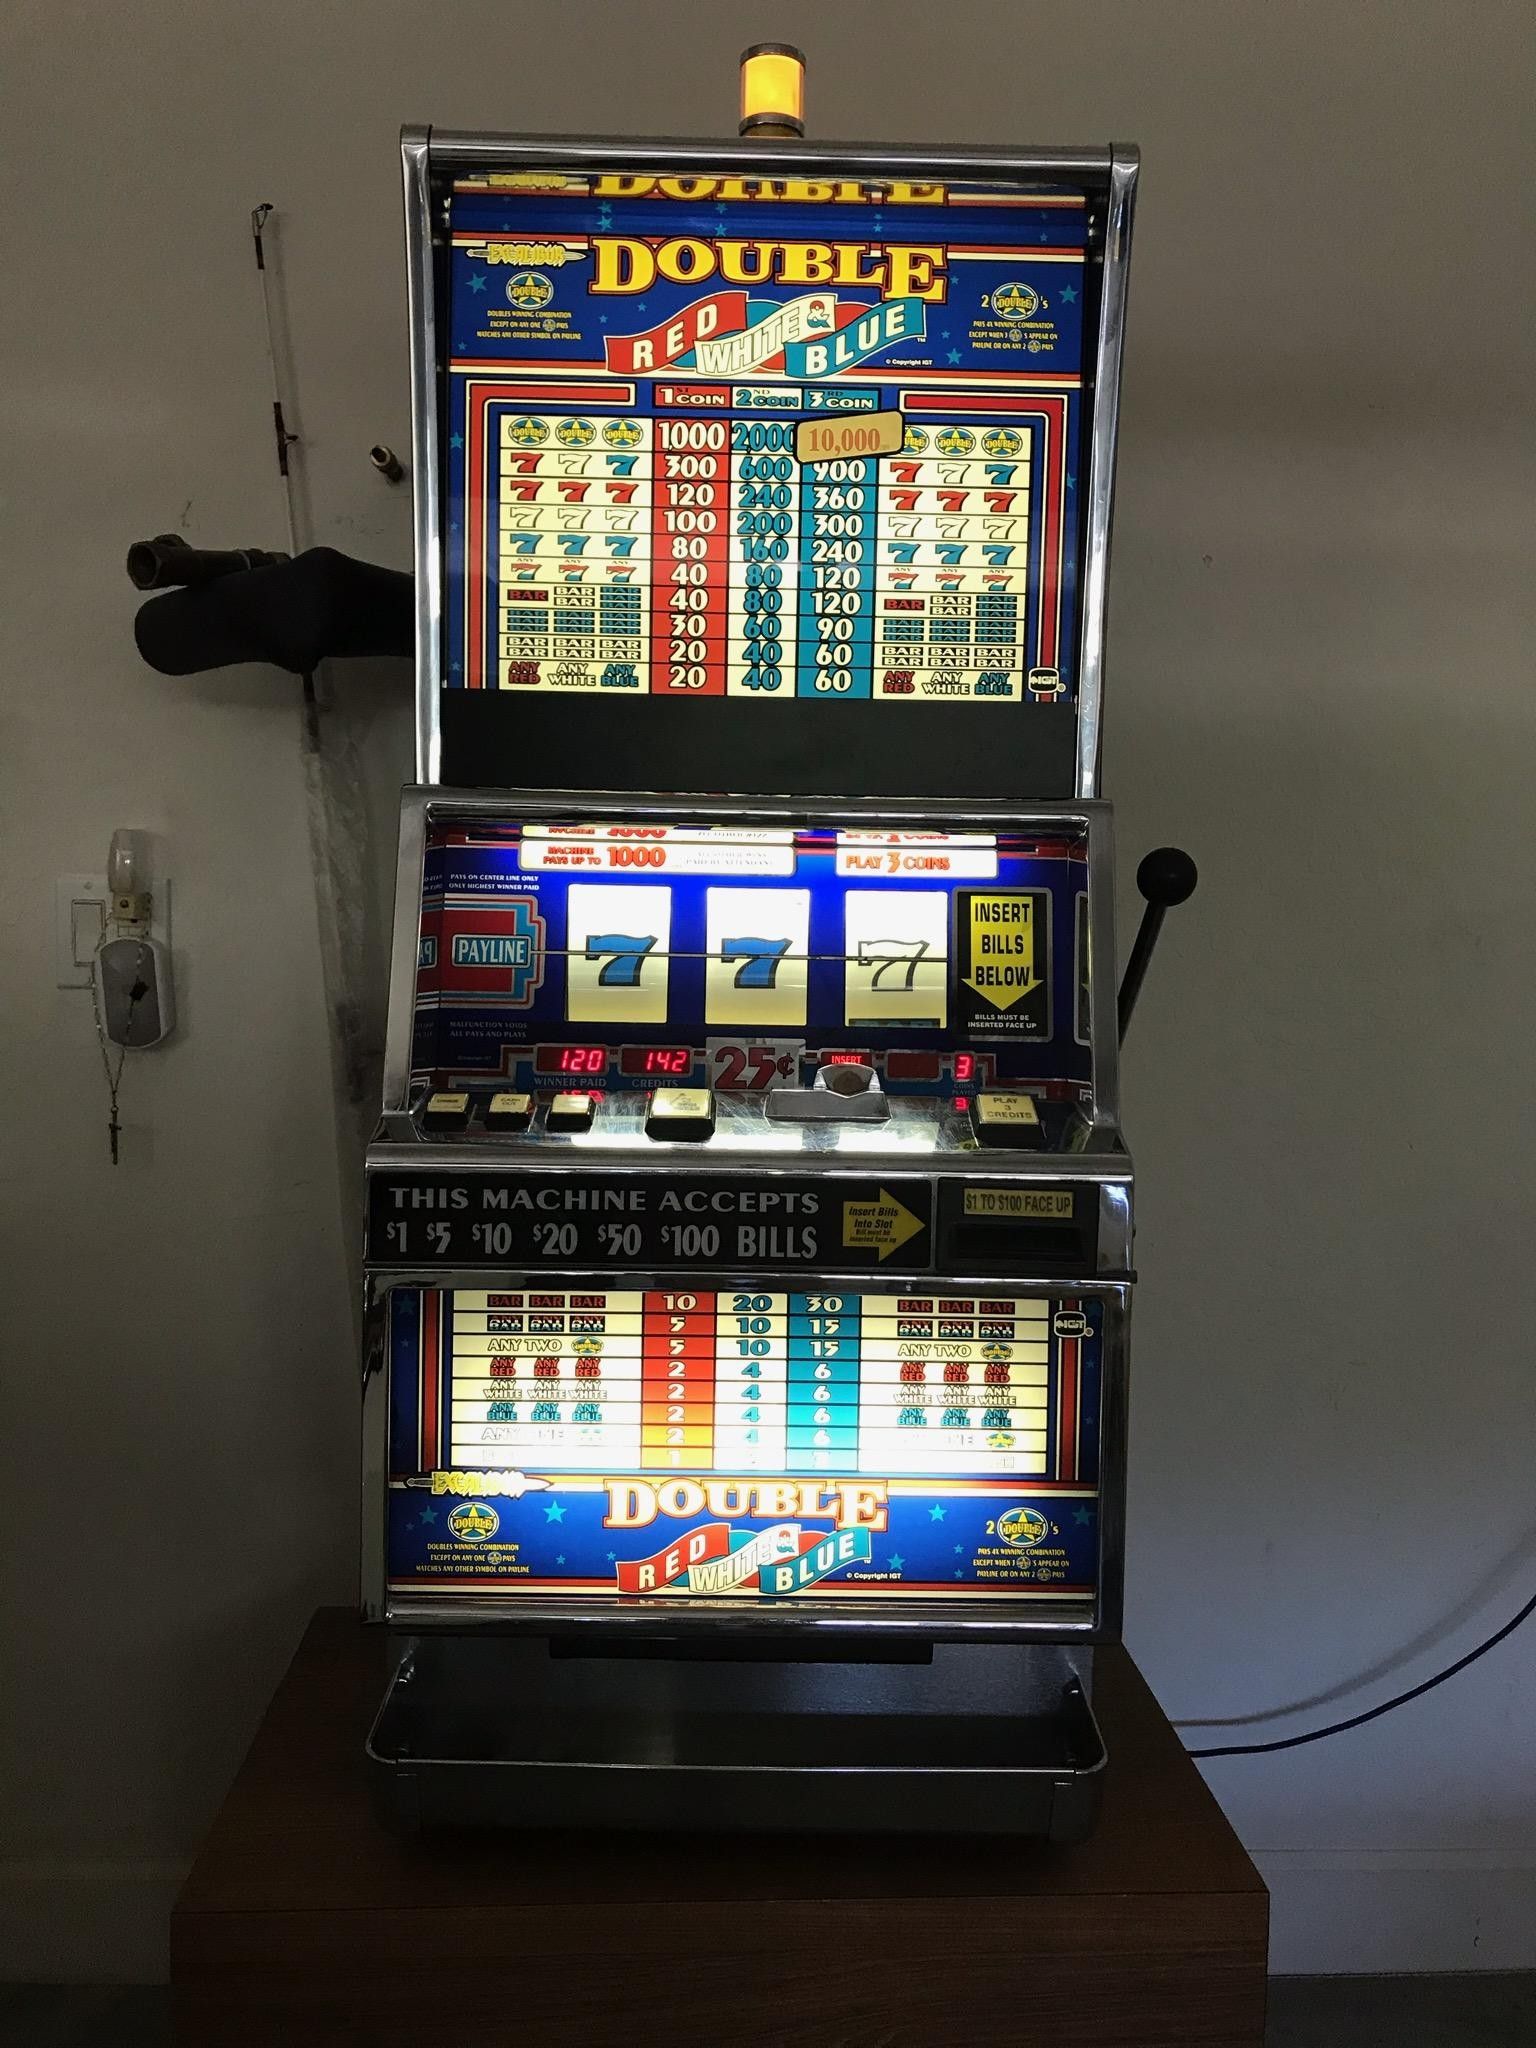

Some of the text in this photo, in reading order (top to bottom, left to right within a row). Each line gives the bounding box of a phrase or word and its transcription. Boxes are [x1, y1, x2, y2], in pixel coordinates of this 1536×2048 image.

[588, 236, 948, 304] DOUBLE
[632, 300, 905, 376] RED WHITE & BLUE
[892, 358, 921, 366] Copyright
[675, 394, 725, 405] COIN
[753, 395, 799, 407] COIN
[825, 398, 873, 409] COIN
[809, 428, 881, 455] 10,000
[510, 452, 639, 476] 7 7 7
[665, 455, 866, 484] 300 600 900
[666, 483, 865, 510] 120 240 360
[663, 510, 863, 537] 100 200 300
[671, 536, 863, 563] 80 160 240
[670, 563, 861, 590] 40 80 120
[669, 614, 853, 641] 30 60 90
[669, 639, 852, 667] 20 40 60
[543, 856, 602, 865] PAYS UP TO
[547, 847, 595, 855] MACHINE
[606, 846, 667, 868] 1000
[845, 852, 950, 873] PLAY 3 COINS
[975, 903, 1030, 922] INSERT
[458, 939, 526, 964] PAYLINE
[982, 934, 1024, 955] BILLS
[585, 933, 930, 992] 7 7 7
[975, 966, 1030, 987] BELOW
[450, 1021, 503, 1029] MALFUNCTION
[504, 1031, 527, 1039] PLAYS
[561, 1050, 602, 1071] 120
[647, 1051, 687, 1072] 142
[831, 1055, 862, 1065] INSERT
[956, 1054, 971, 1079] 3
[534, 1077, 607, 1087] WINNER PAID
[632, 1079, 679, 1088] CREDITS
[987, 1110, 1032, 1119] CREDITS
[388, 1188, 820, 1214] THIS MACHINE ACCEPTS
[848, 1206, 899, 1217] Insert Bills
[965, 1193, 1071, 1213] $1 TO $100 FACE UP
[854, 1219, 893, 1229] Into Slot
[387, 1221, 817, 1259] $1 $5 $10 $20 $50 $100 BILLS
[488, 1295, 522, 1307] BAR
[662, 1295, 843, 1312] 10 20 30
[488, 1339, 562, 1352] ANY TWO
[602, 1477, 888, 1532] DOUBLE
[455, 1519, 493, 1530] DOUBLE
[986, 1521, 995, 1535] 2
[1003, 1523, 1042, 1535] DOUBLE
[431, 1554, 515, 1562] EXCEPT ON ANY ONE PAYS
[638, 1533, 705, 1590] RED
[693, 1535, 772, 1592] WHITE
[776, 1532, 855, 1593] BLUE
[978, 1548, 1065, 1556] PAYS 4X WINNING COMBINATION
[416, 1565, 530, 1573] MATCHES ANY OTHER SYMBOL ON PAYLINE
[853, 1572, 888, 1580] Copyright
